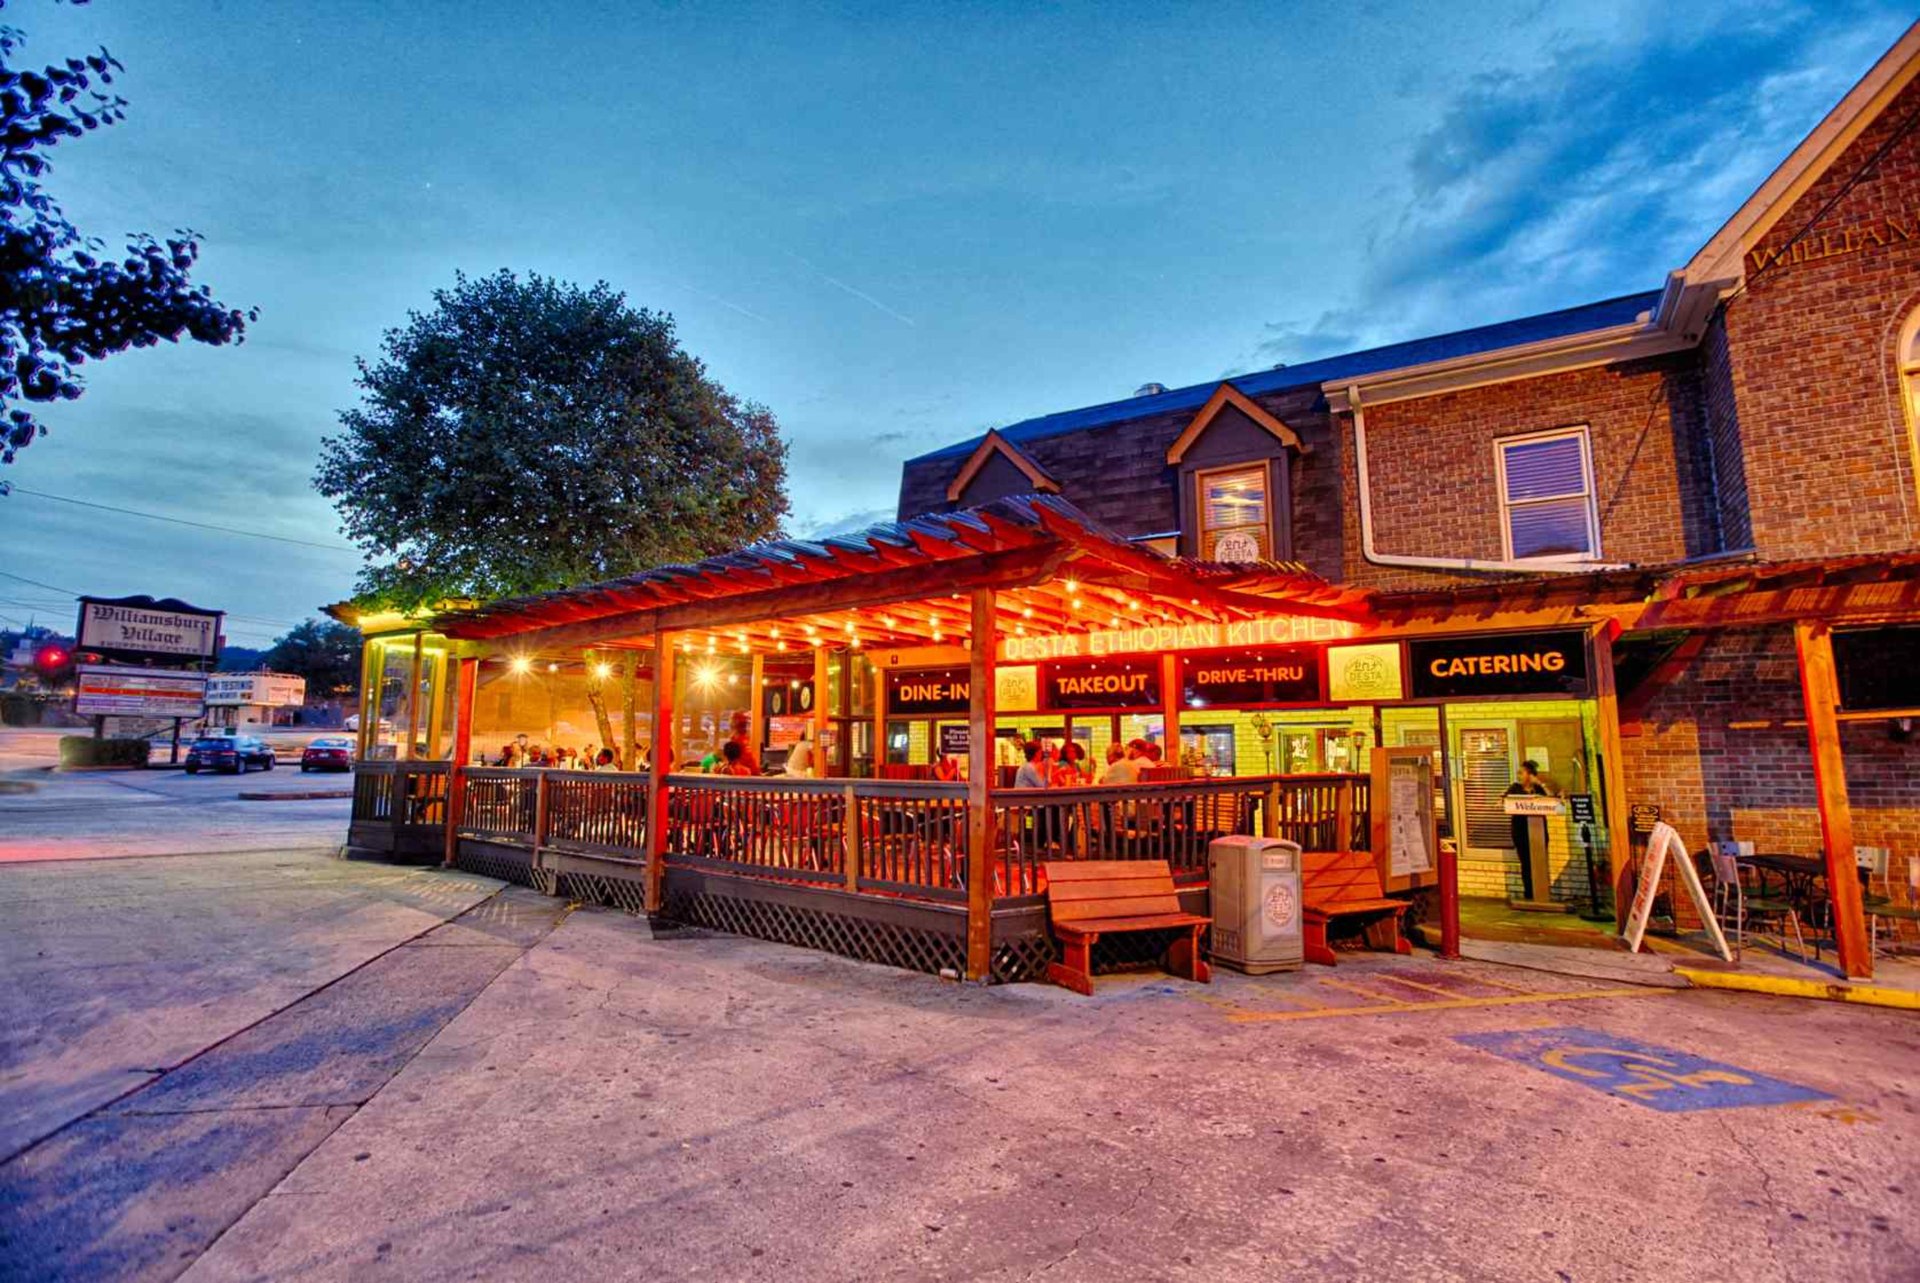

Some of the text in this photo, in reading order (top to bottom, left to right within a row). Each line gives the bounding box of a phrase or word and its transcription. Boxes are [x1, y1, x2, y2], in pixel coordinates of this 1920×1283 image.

[93, 606, 212, 632] Williamsburg
[121, 625, 183, 644] Village
[1005, 616, 1349, 660] DESTA ETHIOPIAN KITCHEN
[1430, 651, 1565, 677] CATERING
[1057, 674, 1149, 694] TAKEOUT
[1197, 666, 1304, 684] DRIVE-THRU
[900, 683, 970, 701] DINE-IN
[1515, 802, 1557, 811] Welcome
